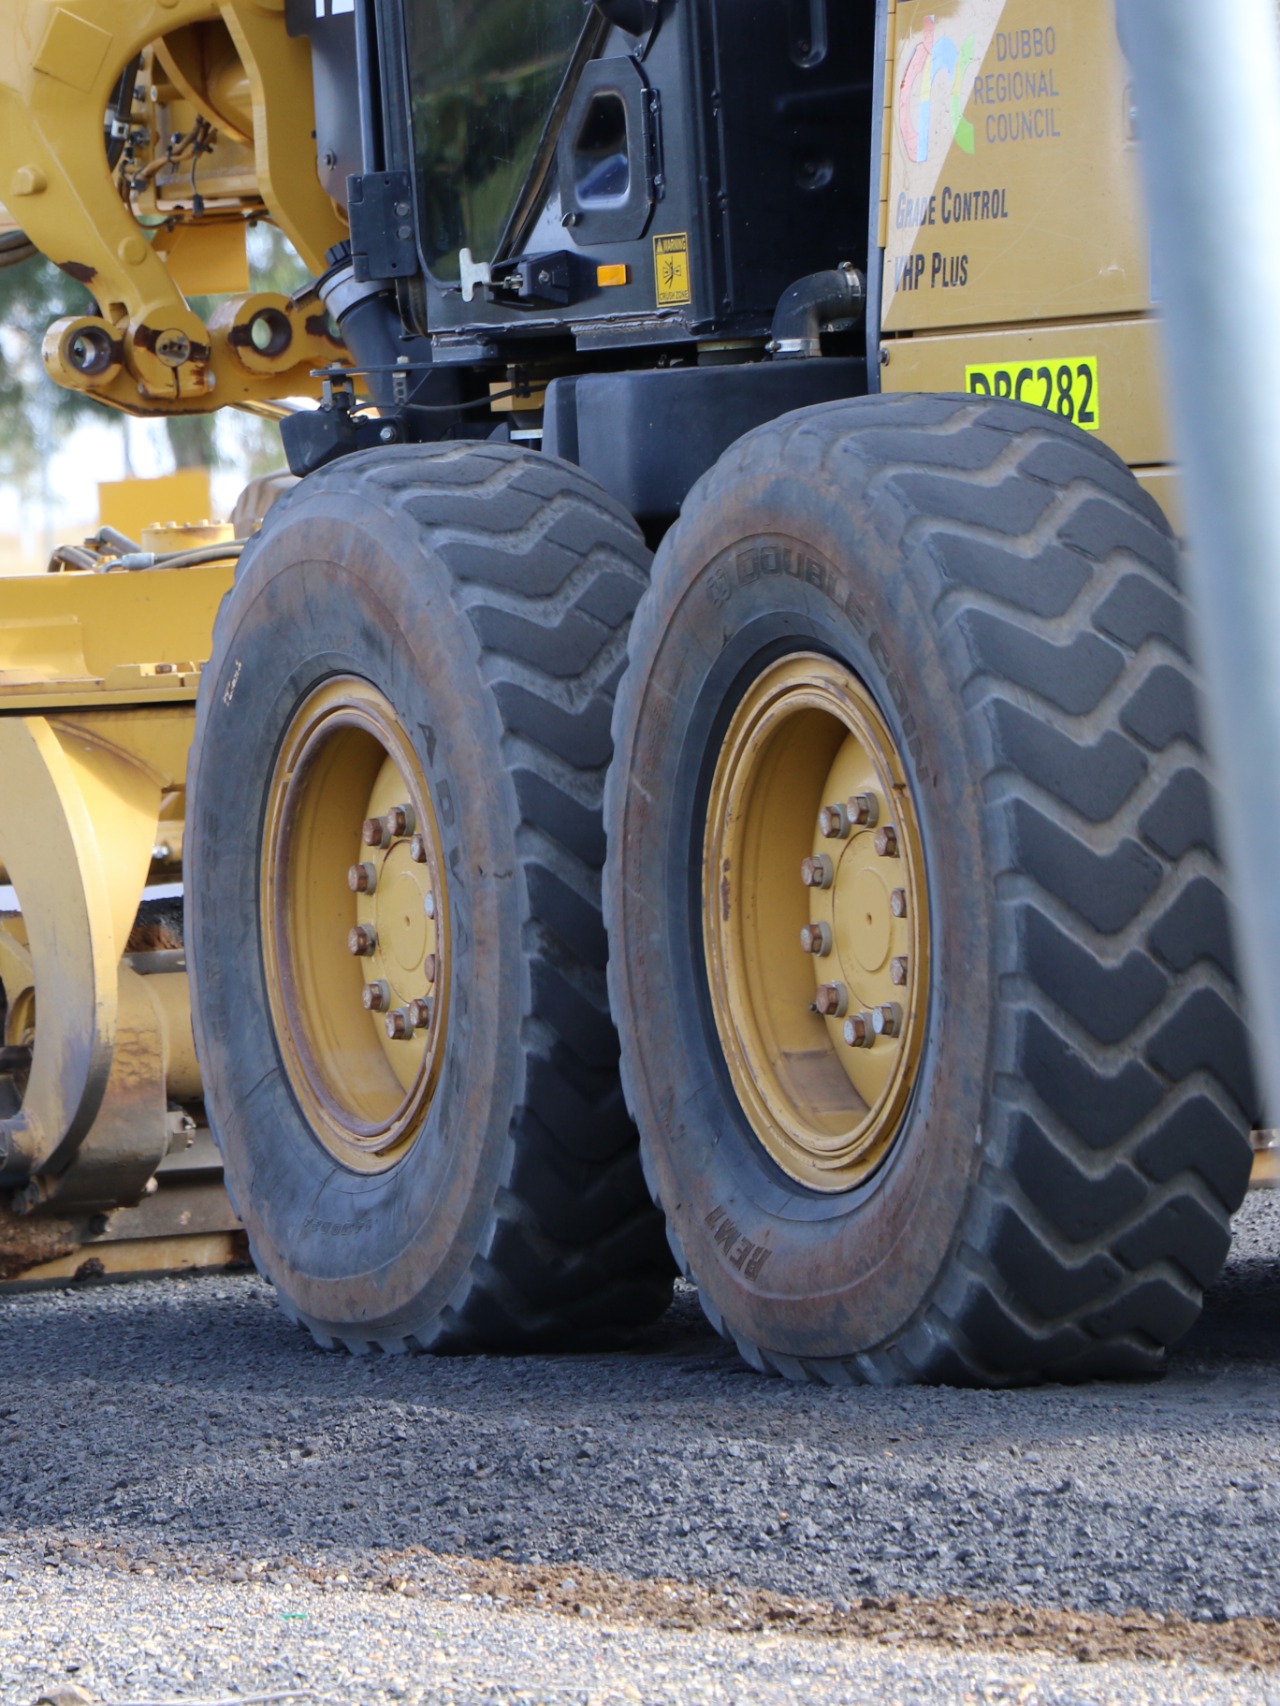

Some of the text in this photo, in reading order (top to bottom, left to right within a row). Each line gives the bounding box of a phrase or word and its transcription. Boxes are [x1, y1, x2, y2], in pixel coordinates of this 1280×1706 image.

[995, 26, 1057, 63] DUBBO
[972, 67, 1061, 106] REGIONAL
[985, 107, 1062, 145] COUNCIL
[941, 186, 1009, 224] CONTROL
[931, 251, 969, 289] PLUS
